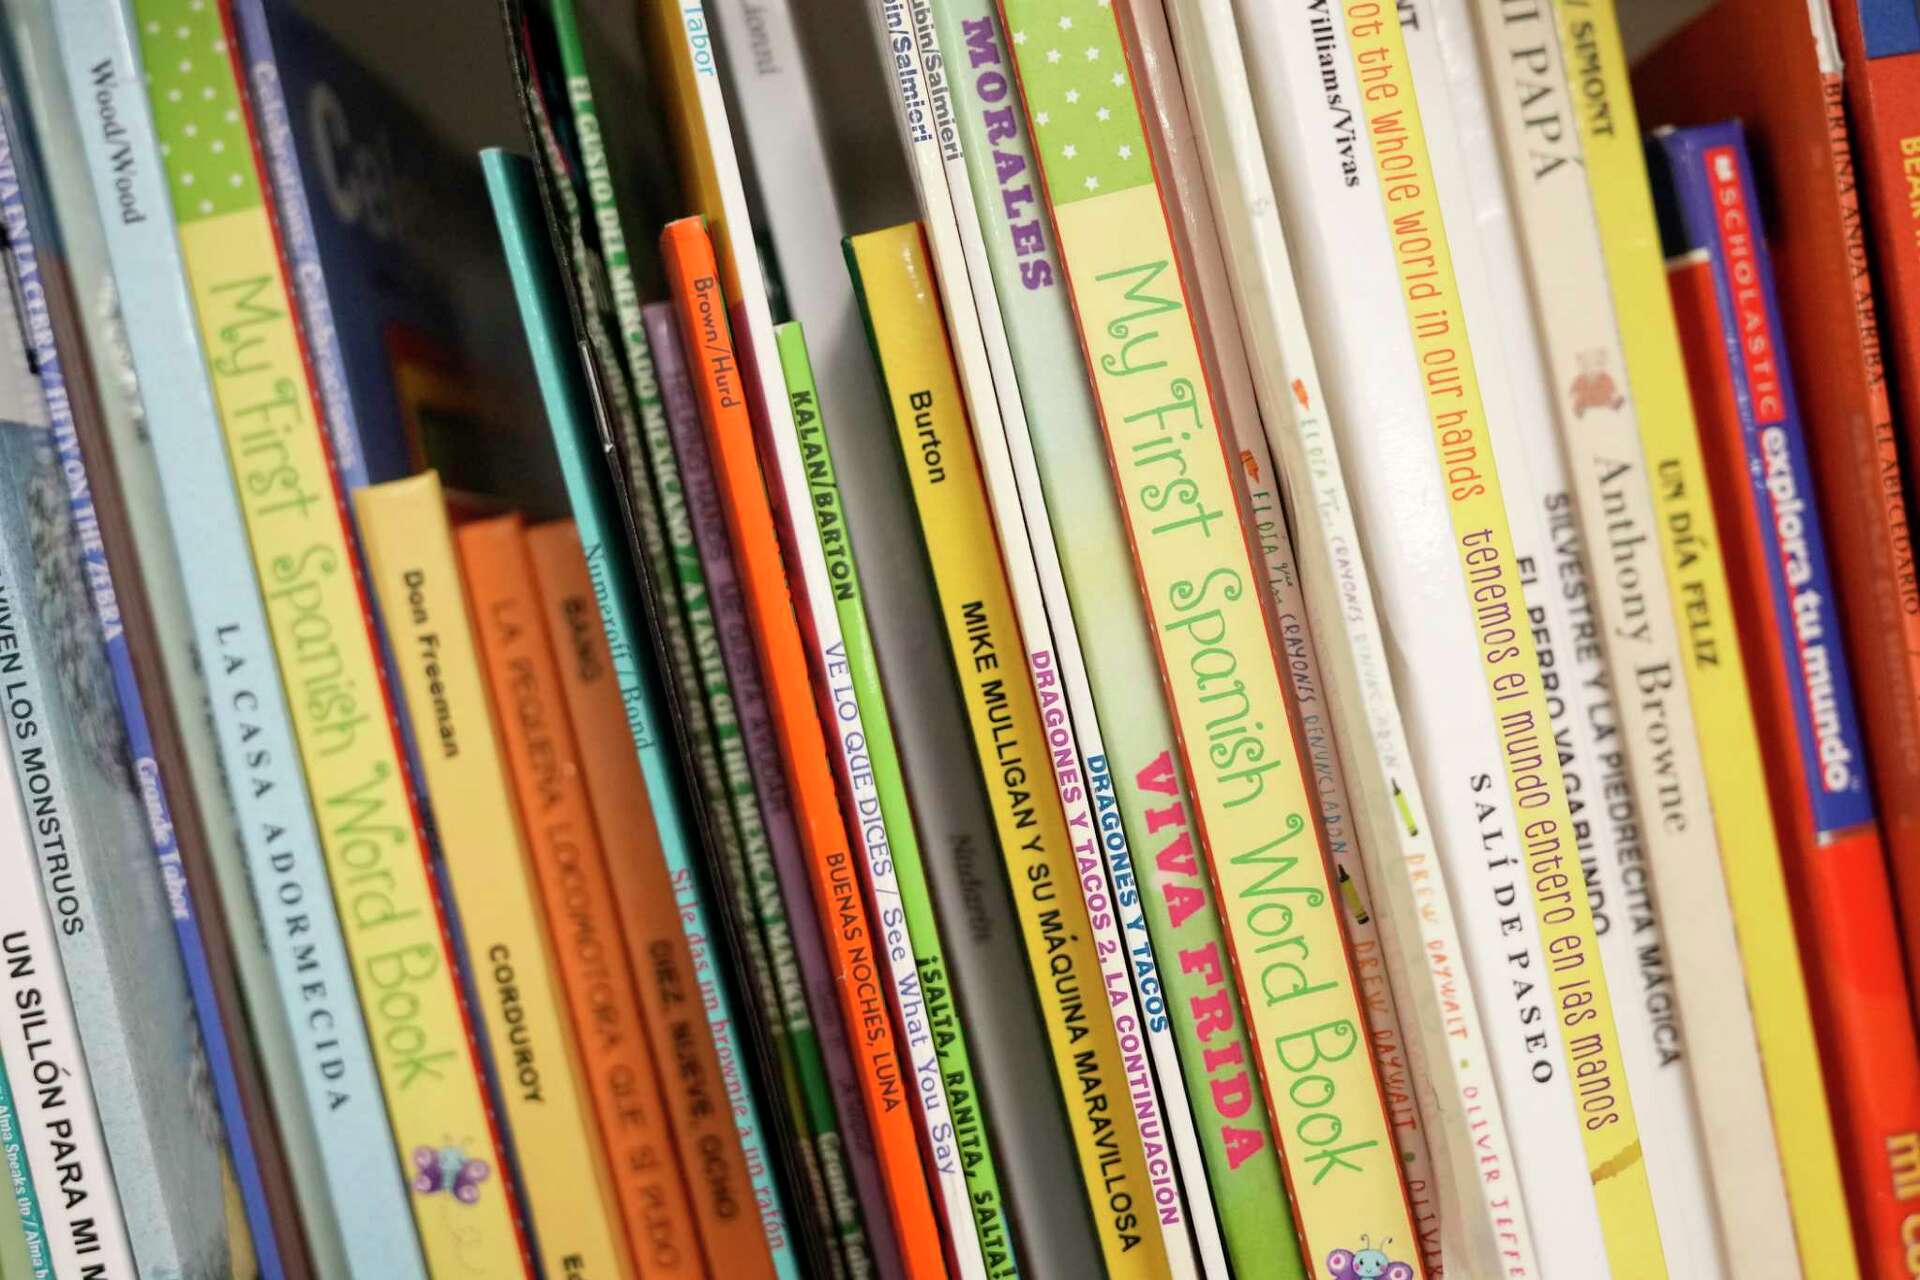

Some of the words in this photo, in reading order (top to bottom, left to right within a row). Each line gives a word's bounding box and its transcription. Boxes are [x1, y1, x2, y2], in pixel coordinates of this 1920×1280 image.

[568, 72, 594, 109] EL
[1356, 45, 1399, 102] the
[1510, 44, 1585, 180] PAPÁ
[1569, 16, 1615, 142] SIMONT
[84, 57, 148, 227] Wood/Wood
[573, 113, 615, 203] GUSTO
[960, 14, 1053, 292] MORALES
[1369, 109, 1422, 203] whole
[1820, 82, 1857, 196] BERTINA
[12, 242, 39, 278] LA
[594, 205, 628, 261] DEL
[1391, 209, 1443, 302] world
[1838, 205, 1869, 278] ANDA
[21, 278, 59, 364] CEBRA
[208, 273, 286, 378] My
[607, 262, 659, 399] MERCADO
[687, 274, 744, 409] Brown/Hurd
[1094, 259, 1184, 378] My
[1412, 308, 1452, 343] in
[1713, 188, 1779, 419] SCHOLASTIC
[45, 385, 80, 455] FIFTY
[1420, 346, 1465, 403] our
[62, 457, 90, 497] ON
[233, 378, 320, 520] First
[638, 401, 693, 549] MEXICANO
[908, 390, 952, 484] Burton
[1123, 377, 1225, 539] First
[1433, 408, 1487, 502] hands
[1656, 456, 1688, 501] UN
[1873, 421, 1896, 449] EL
[73, 504, 105, 557] THE
[790, 388, 856, 603] KALAN/BARTON
[1666, 509, 1707, 568] DÍA
[1759, 423, 1816, 584] explora
[1877, 455, 1920, 617] ABECEDARIO
[85, 556, 124, 641] ZEBRA
[401, 567, 433, 625] Don
[491, 596, 526, 645] LA
[1251, 491, 1272, 513] EL
[1277, 611, 1316, 704] CRAYONES
[1328, 533, 1365, 622] CRAYONES
[1459, 528, 1521, 664] tenemos
[1544, 491, 1600, 662] SILVESTRE
[1679, 577, 1721, 669] FELIZ
[1791, 588, 1829, 640] tu
[214, 622, 250, 675] LA
[269, 542, 370, 758] Spanish
[578, 541, 631, 662] Numeroff
[619, 685, 654, 751] Bond
[686, 602, 729, 690] TASTE
[822, 640, 849, 675] VE
[960, 599, 998, 672] MIKE
[1581, 669, 1607, 690] Y
[1594, 452, 1656, 650] Anthony
[1634, 656, 1696, 833] Browne
[5, 680, 39, 742] LOS
[415, 631, 465, 760] Freeman
[708, 690, 738, 730] OF
[832, 684, 859, 723] LO
[1030, 650, 1083, 804] DRAGONES
[1163, 566, 1282, 808] Spanish
[1490, 671, 1529, 702] el
[1586, 700, 1617, 740] LA
[1799, 643, 1857, 793] mundo
[227, 687, 280, 800] CASA
[719, 733, 753, 790] THE
[840, 729, 875, 790] QUE
[979, 678, 1038, 829] MULLIGAN
[1498, 709, 1553, 812] mundo
[1527, 605, 1567, 720] PERRO
[1551, 728, 1612, 935] VAGABUNDO
[21, 745, 85, 937] MONSTRUOS
[134, 755, 175, 847] Grande
[157, 846, 197, 923] Tabor
[326, 760, 421, 932] Word
[733, 791, 785, 917] MEXICAN
[856, 795, 895, 877] DICES
[1019, 832, 1044, 855] Y
[1067, 812, 1088, 831] Y
[1085, 753, 1139, 908] DRAGONES
[1466, 772, 1512, 872] SALÍ
[1596, 750, 1657, 935] PIEDRECITA
[668, 866, 694, 894] Si
[677, 900, 702, 925] le
[1025, 861, 1055, 903] SU
[1073, 839, 1112, 930] TACOS
[1230, 813, 1340, 1007] Word
[1492, 883, 1523, 936] DE
[1521, 818, 1576, 926] entero
[0, 930, 35, 980] UN
[261, 818, 352, 1111] ADORMECIDA
[685, 930, 714, 971] das
[881, 906, 912, 962] See
[1092, 938, 1119, 965] 2,
[1124, 912, 1145, 932] Y
[1130, 750, 1210, 928] VIVA
[1176, 941, 1270, 1170] FRIDA
[1403, 851, 1441, 927] DREW
[1425, 937, 1468, 1041] DAYWALT
[1547, 932, 1586, 972] en
[365, 946, 458, 1089] Book
[697, 978, 720, 1012] un
[766, 919, 813, 1032] MARKET
[823, 850, 864, 941] BUENAS
[844, 946, 889, 1047] NOCHES,
[870, 1050, 905, 1112] LUNA
[895, 971, 932, 1045] What
[1036, 908, 1092, 1044] MÁQUINA
[1103, 972, 1128, 1005] LA
[1130, 941, 1169, 1034] TACOS
[1503, 948, 1557, 1085] PASEO
[1556, 978, 1598, 1027] las
[1636, 941, 1683, 1066] MÁGICA
[12, 985, 70, 1111] SILLÓN
[486, 943, 545, 1106] CORDUROY
[708, 1017, 754, 1117] brownie
[1351, 939, 1390, 1016] DREW
[1372, 1027, 1417, 1133] DAYWALT
[912, 954, 963, 1059] ¡SALTA,
[939, 1069, 991, 1180] RANITA,
[969, 1189, 1016, 1280] SALTA!
[915, 1060, 946, 1110] You
[1112, 1014, 1181, 1227] CONTINUACIÓN
[1274, 1018, 1379, 1186] Book
[1567, 1033, 1621, 1132] manos
[44, 1117, 90, 1209] PARA
[743, 1145, 765, 1176] un
[928, 1121, 961, 1177] Say
[1072, 1049, 1144, 1253] MARAVILLOSA
[1461, 1083, 1503, 1184] OLIVER
[4, 1142, 29, 1194] Speaks
[24, 1228, 45, 1266] Alma
[68, 1216, 100, 1256] MI
[753, 1184, 792, 1251] ratón
